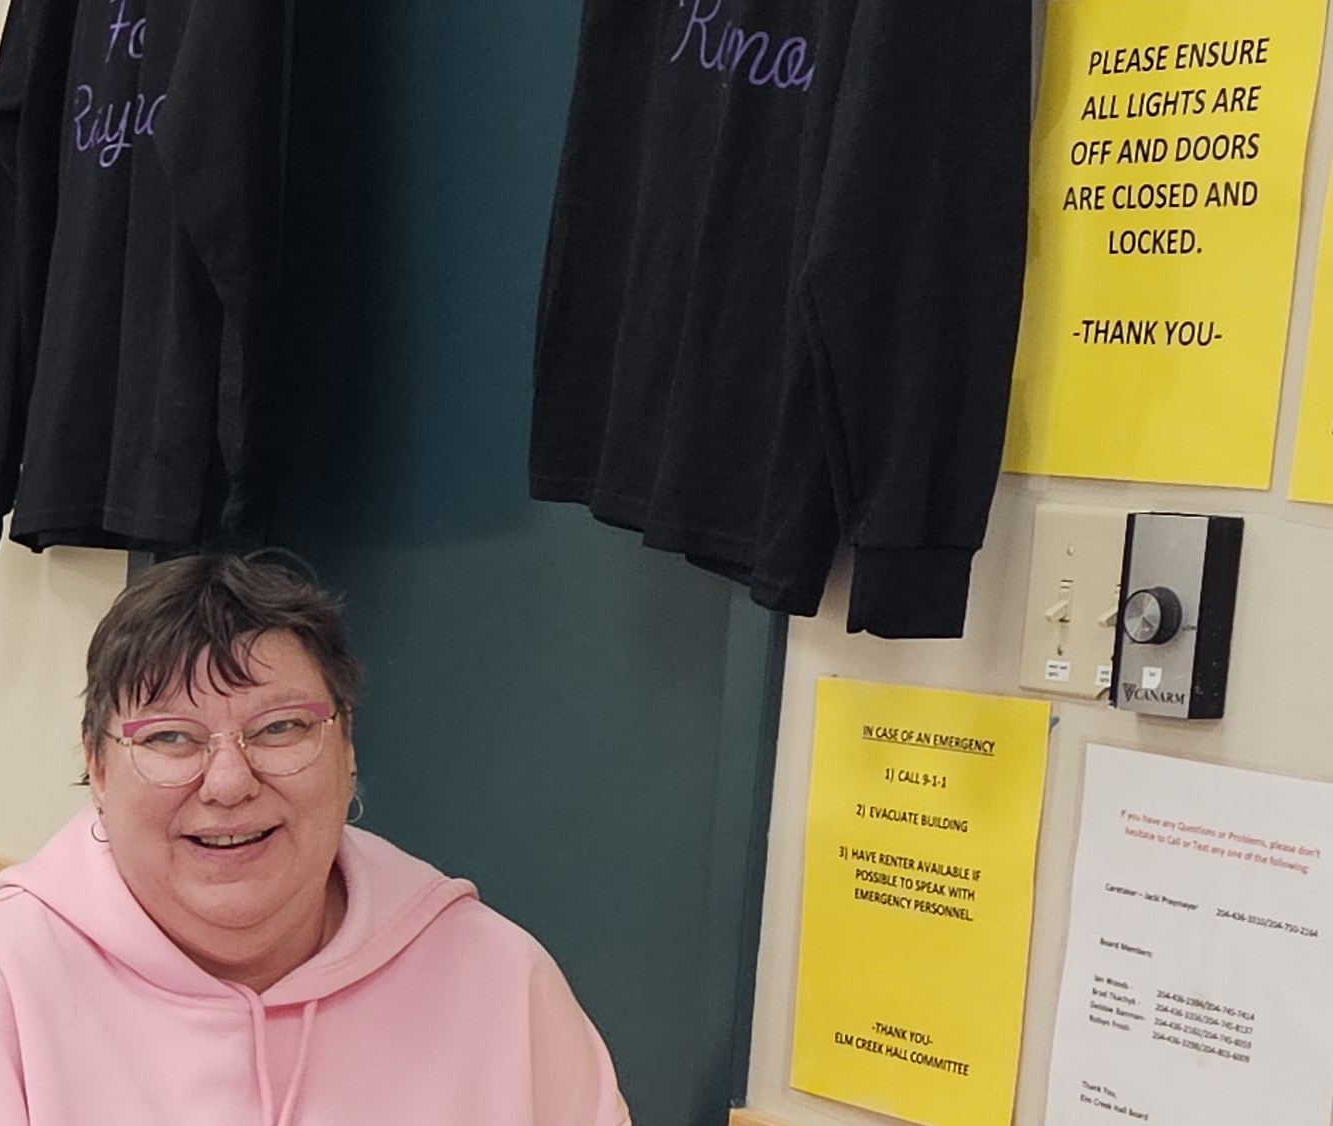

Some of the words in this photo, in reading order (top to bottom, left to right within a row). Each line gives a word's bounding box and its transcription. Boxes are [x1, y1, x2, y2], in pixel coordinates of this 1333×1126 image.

[1088, 46, 1169, 75] PLEASE
[1175, 37, 1270, 69] ENSURE
[1081, 94, 1119, 120] ALL
[1127, 88, 1205, 118] LIGHTS
[1212, 85, 1261, 113] ARE
[1070, 140, 1112, 165] OFF
[1117, 137, 1168, 164] AND
[1175, 133, 1260, 162] DOORS
[1063, 186, 1105, 210] ARE
[1112, 183, 1198, 209] CLOSED
[1204, 181, 1258, 207] AND
[1109, 229, 1202, 255] LOCKED.
[1073, 319, 1157, 345] -THANK
[1164, 321, 1222, 346] YOU-
[1135, 689, 1185, 705] CANARM
[863, 724, 874, 738] IN
[877, 727, 899, 742] CASE
[901, 729, 914, 743] OF
[916, 730, 930, 745] AN
[933, 732, 995, 754] EMERGENCY
[885, 768, 894, 783] 1)
[899, 770, 920, 785] CALL
[923, 773, 947, 788] 9-1-1
[856, 804, 865, 818] 2)
[869, 805, 919, 826] EVACUATE
[922, 812, 968, 833] BUILDING
[839, 846, 848, 860] 3)
[852, 847, 876, 864] HAVE
[879, 852, 915, 871] RENTER
[917, 858, 970, 880] AVAILABLE
[972, 868, 981, 882] IF
[855, 887, 912, 911] EMERGENCY
[856, 868, 897, 889] POSSIBLE
[900, 876, 913, 890] TO
[915, 878, 946, 896] SPEAK
[948, 884, 975, 902] WITH
[834, 1031, 854, 1047] ELM
[856, 1036, 883, 1057] CREEK
[885, 1043, 909, 1062] HALL
[910, 1049, 969, 1076] COMMITTEE
